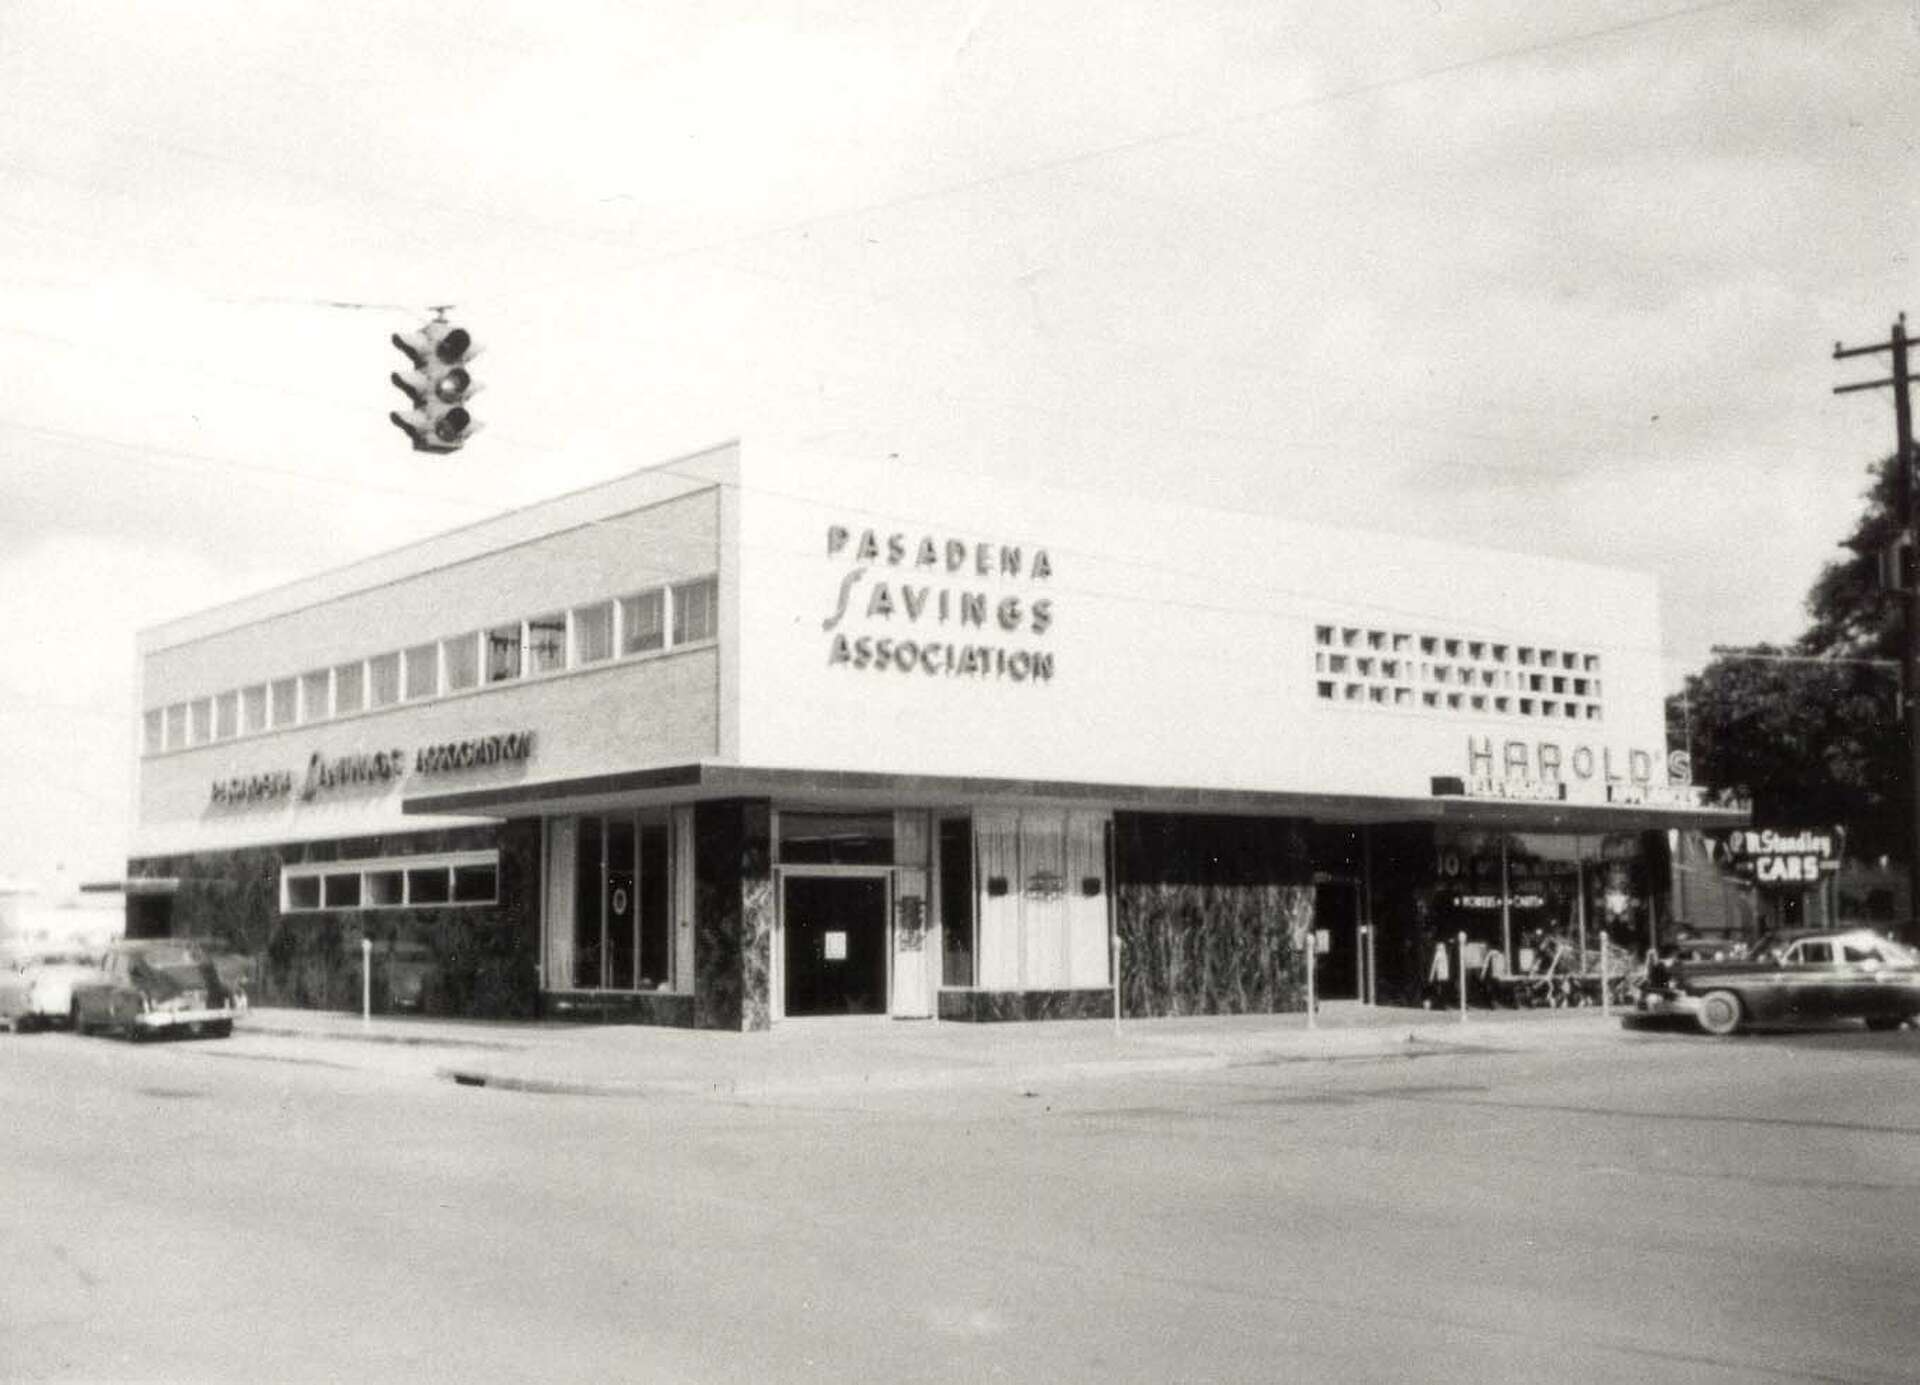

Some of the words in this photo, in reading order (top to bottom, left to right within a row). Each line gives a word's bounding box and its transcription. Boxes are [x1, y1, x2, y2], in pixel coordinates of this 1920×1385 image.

[827, 525, 1052, 579] PASADENA
[821, 566, 1052, 635] SAVINGS
[828, 633, 1054, 682] ASSOCIATION
[1468, 735, 1692, 786] HAROLD'S
[1756, 856, 1819, 881] CARS
